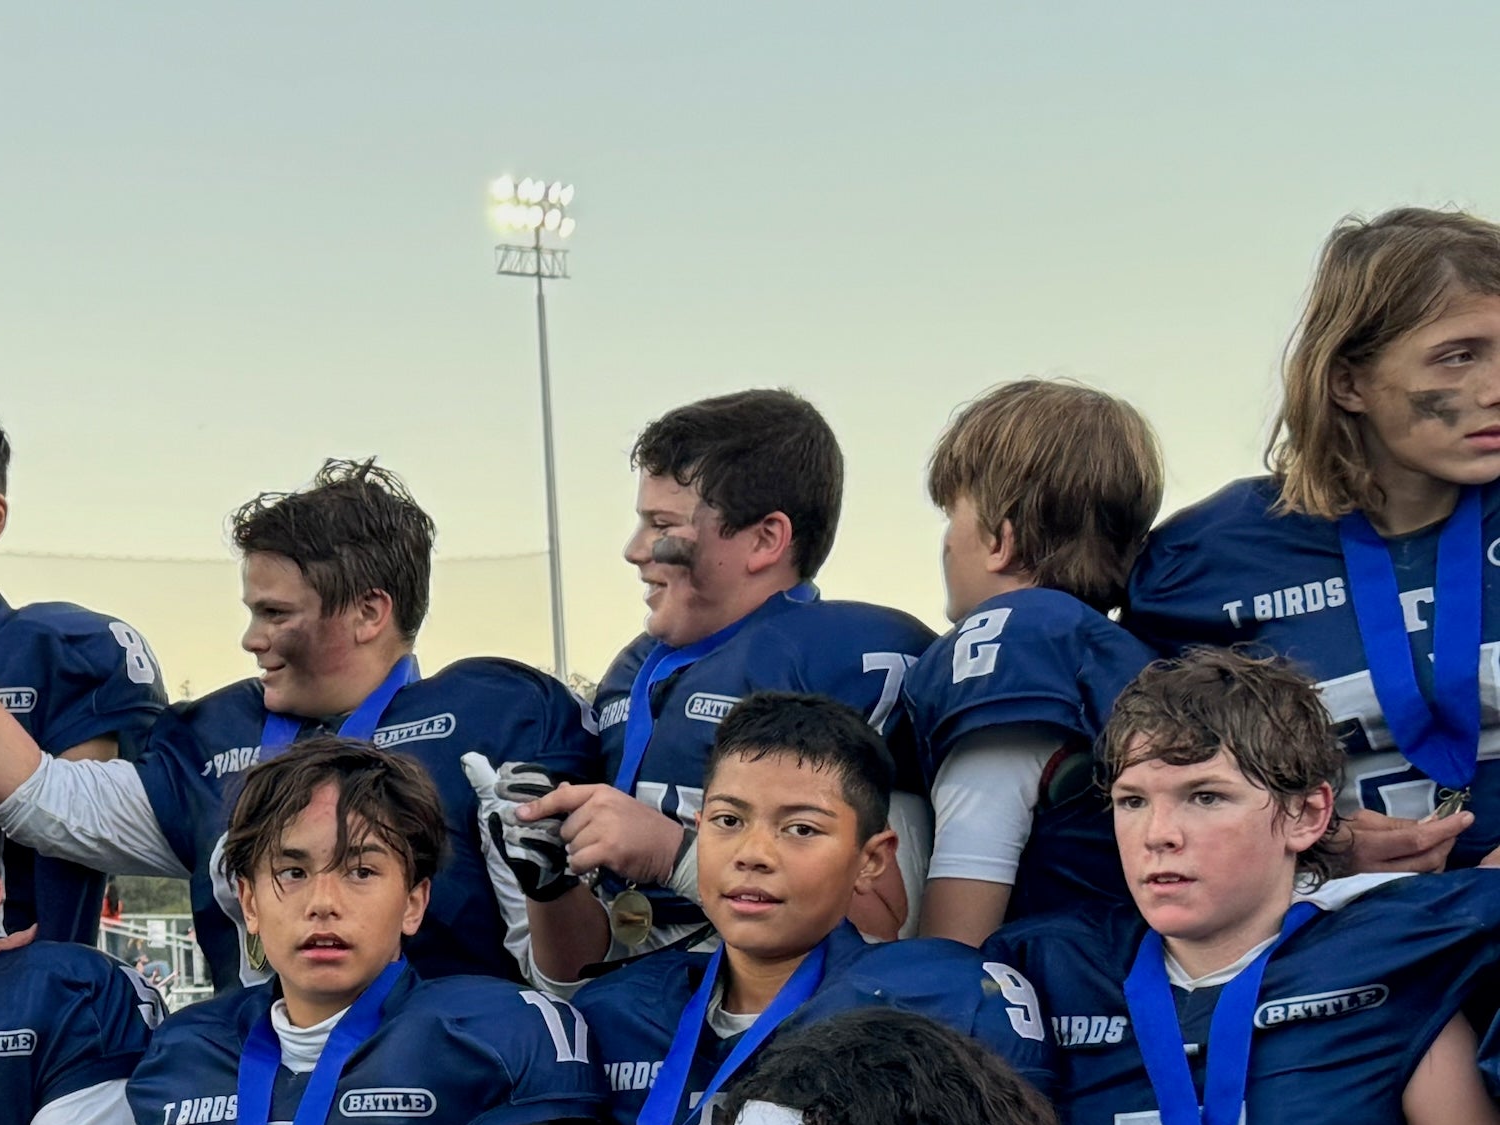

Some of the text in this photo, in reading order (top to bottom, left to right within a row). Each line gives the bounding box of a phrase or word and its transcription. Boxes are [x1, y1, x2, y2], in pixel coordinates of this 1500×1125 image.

[1222, 576, 1346, 629] T BIRDS
[109, 622, 157, 684] 8
[952, 608, 1012, 684] 2
[690, 698, 733, 718] BATT
[862, 652, 919, 736] 7
[373, 718, 447, 746] BATTLE
[982, 961, 1045, 1042] 9
[1265, 990, 1379, 1025] BATTLE
[176, 1095, 237, 1125] BIRDS
[347, 1094, 426, 1112] BATTLE
